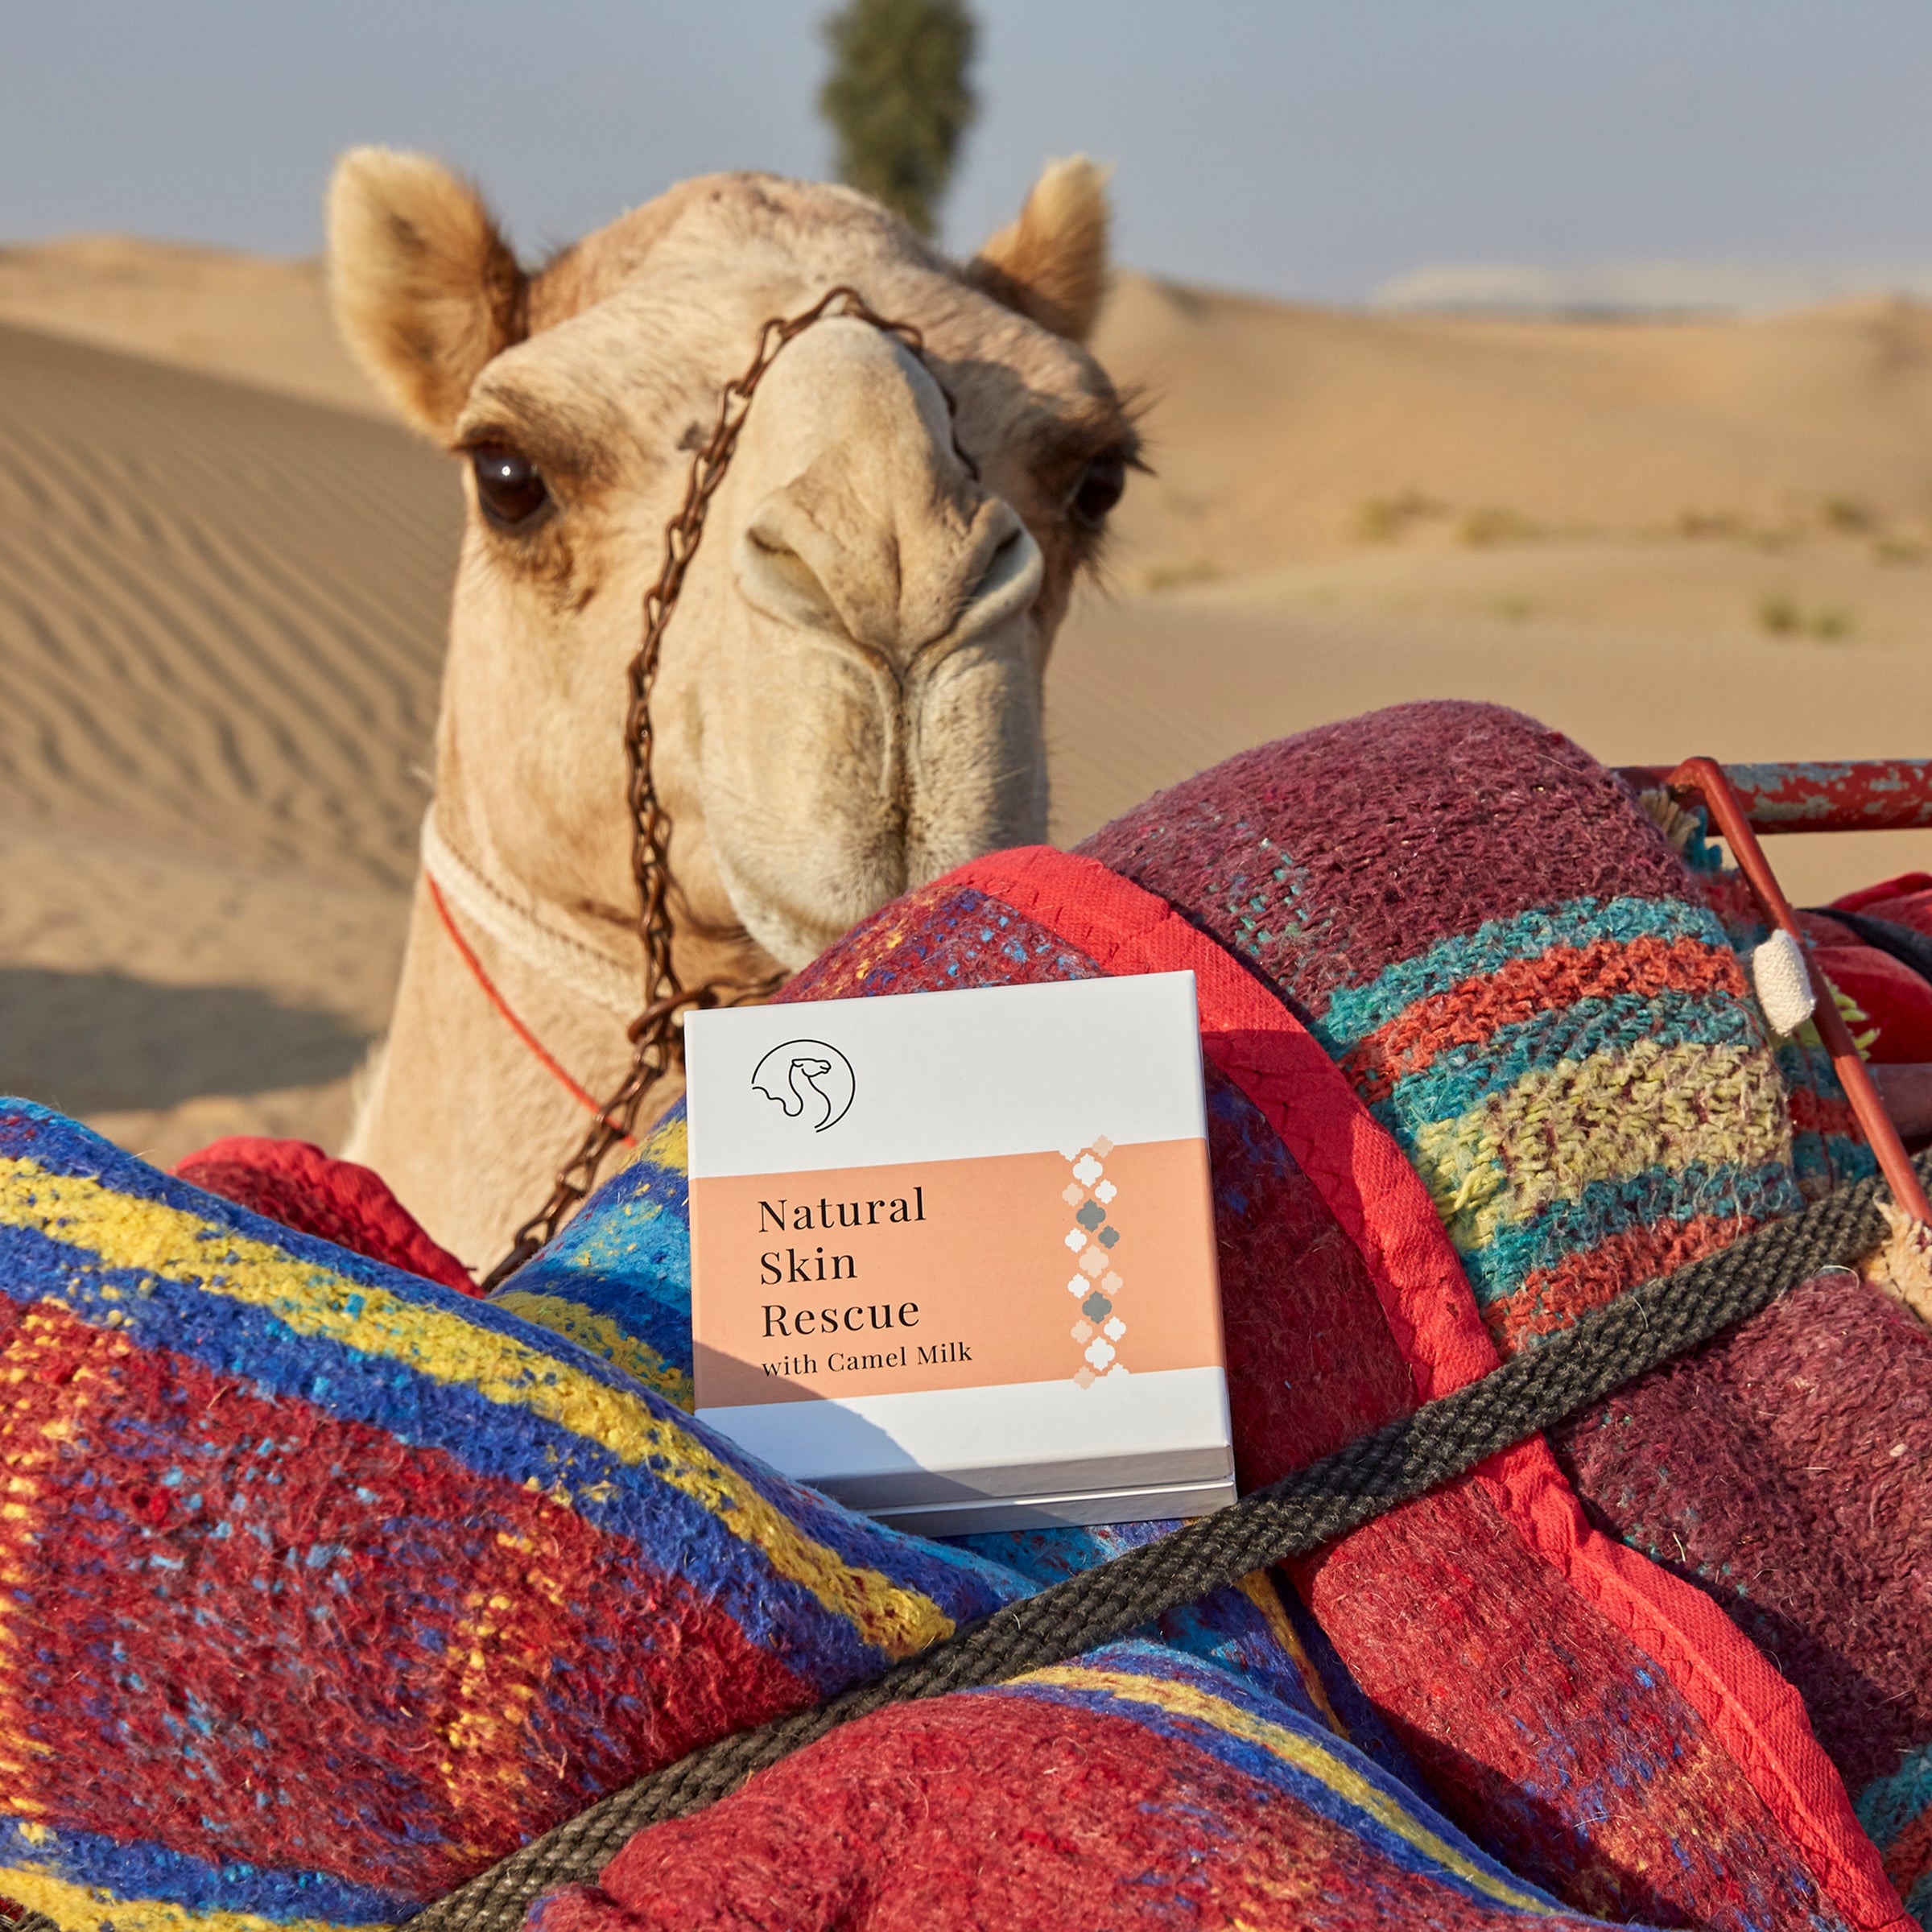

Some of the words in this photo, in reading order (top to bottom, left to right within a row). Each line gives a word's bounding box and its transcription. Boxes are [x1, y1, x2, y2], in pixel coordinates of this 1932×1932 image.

[757, 1186, 927, 1233] Natural
[760, 1247, 858, 1286] Skin
[761, 1302, 920, 1338] Rescue
[762, 1353, 818, 1377] with
[828, 1346, 907, 1373] Camel
[917, 1341, 973, 1365] Milk
